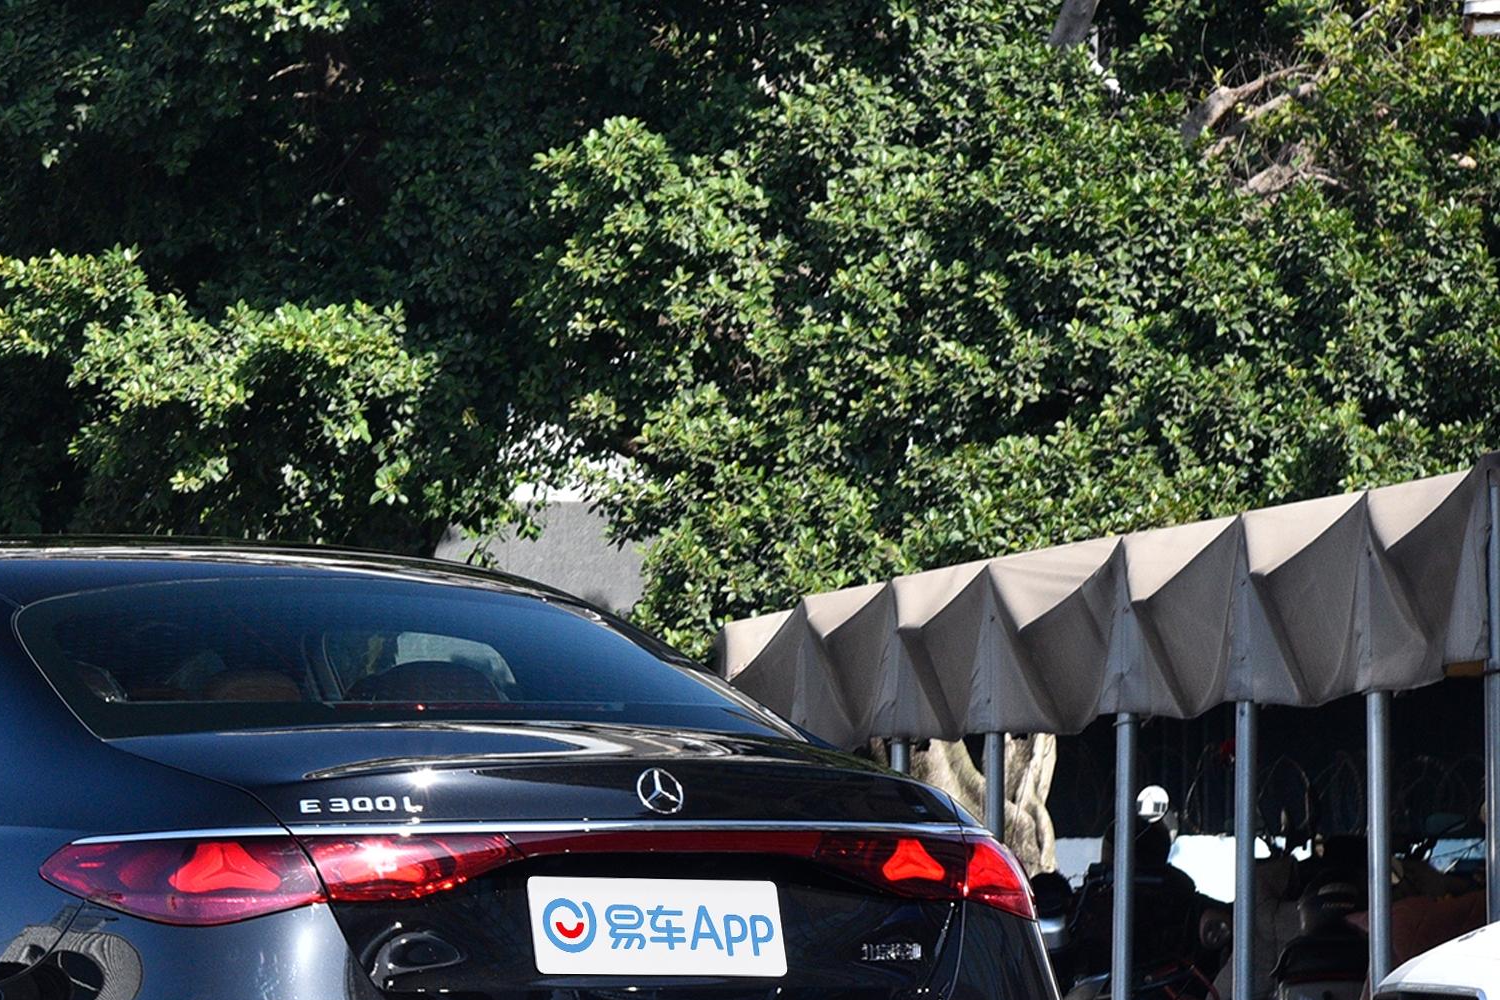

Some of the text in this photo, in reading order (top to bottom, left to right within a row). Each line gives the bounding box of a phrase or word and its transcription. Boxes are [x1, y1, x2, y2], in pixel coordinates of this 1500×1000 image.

[299, 796, 424, 814] E 300 L
[605, 904, 774, 956] 易车App
